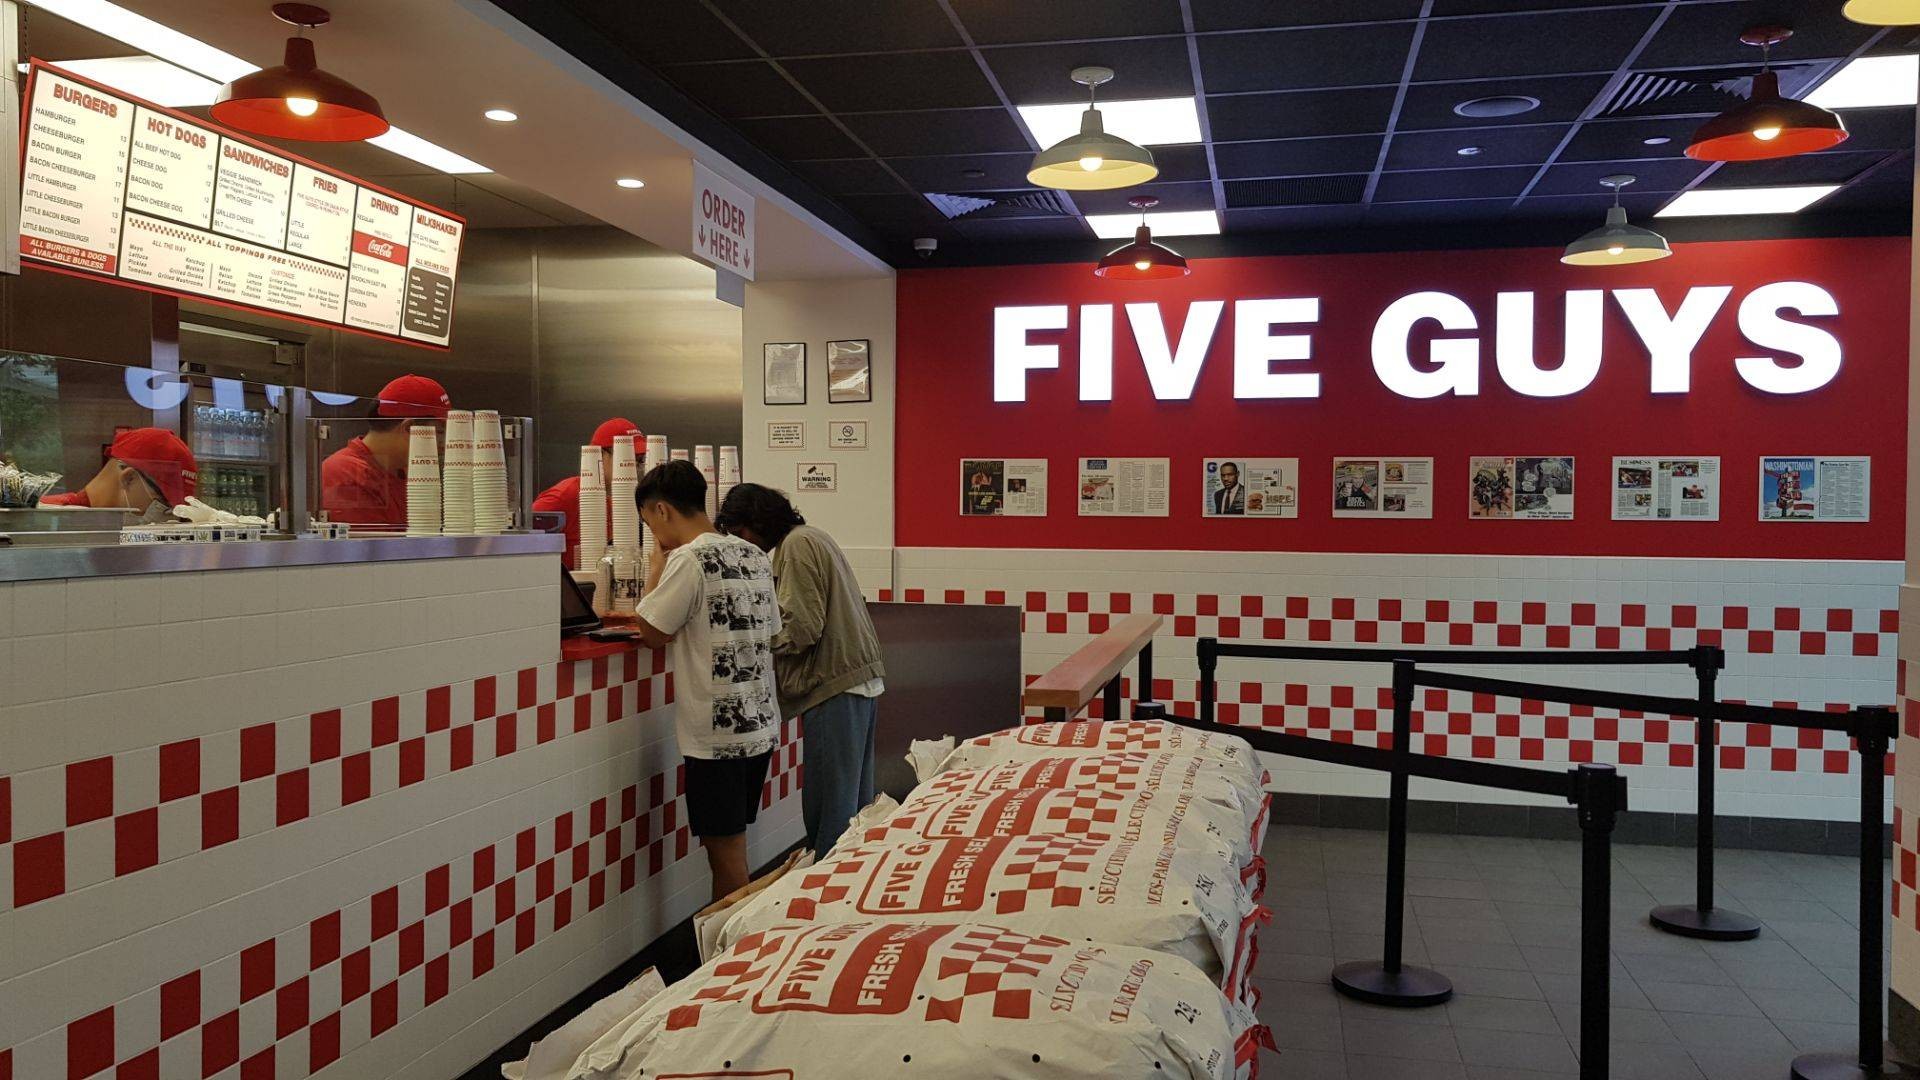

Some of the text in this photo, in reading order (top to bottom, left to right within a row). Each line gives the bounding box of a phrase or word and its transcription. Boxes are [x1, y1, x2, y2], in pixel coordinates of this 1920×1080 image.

[53, 83, 118, 118] BURGERS
[35, 107, 76, 125] HAMBURGER
[33, 123, 84, 144] CHEESEBURGER
[147, 117, 206, 149] HOT DOGS
[31, 140, 82, 160] BACON BURGER
[134, 140, 181, 160] ALL BEEF HOT DOG
[29, 156, 96, 180] BACON CHEESEBURGER
[133, 158, 168, 173] CHEESE DOG
[223, 145, 289, 178] SANDWICHES
[28, 172, 76, 191] LITTLE HAMBURGER
[131, 175, 163, 190] BACON DOG
[313, 176, 338, 194] FRIES
[26, 188, 83, 209] LITTLE CHEESEBURGER
[129, 192, 149, 203] BACON
[149, 198, 170, 209] CHEESE
[370, 197, 399, 216] DRINKS
[24, 205, 80, 224] LITTLE BACON BURGER
[216, 208, 236, 219] GRILLED
[416, 213, 457, 236] MILKSHAKES
[702, 188, 746, 239] ORDER
[23, 222, 37, 230] LITTLE
[39, 225, 54, 234] BACON
[30, 239, 44, 247] ALL
[46, 242, 80, 256] BURGERS
[87, 252, 107, 262] DOGS
[206, 239, 287, 265] ALL TOPPINGS FREE
[710, 228, 739, 268] HERE
[31, 249, 104, 270] AVAILABLE BUNLESS
[993, 280, 1843, 402] FIVE GUYS
[989, 770, 1017, 790] FIVE
[940, 802, 979, 835] FIVE
[994, 799, 1024, 837] FRESH
[879, 861, 922, 908] FIVE
[942, 850, 977, 907] FRESH
[777, 948, 837, 1001] FIVE
[857, 941, 906, 1006] FRESH
